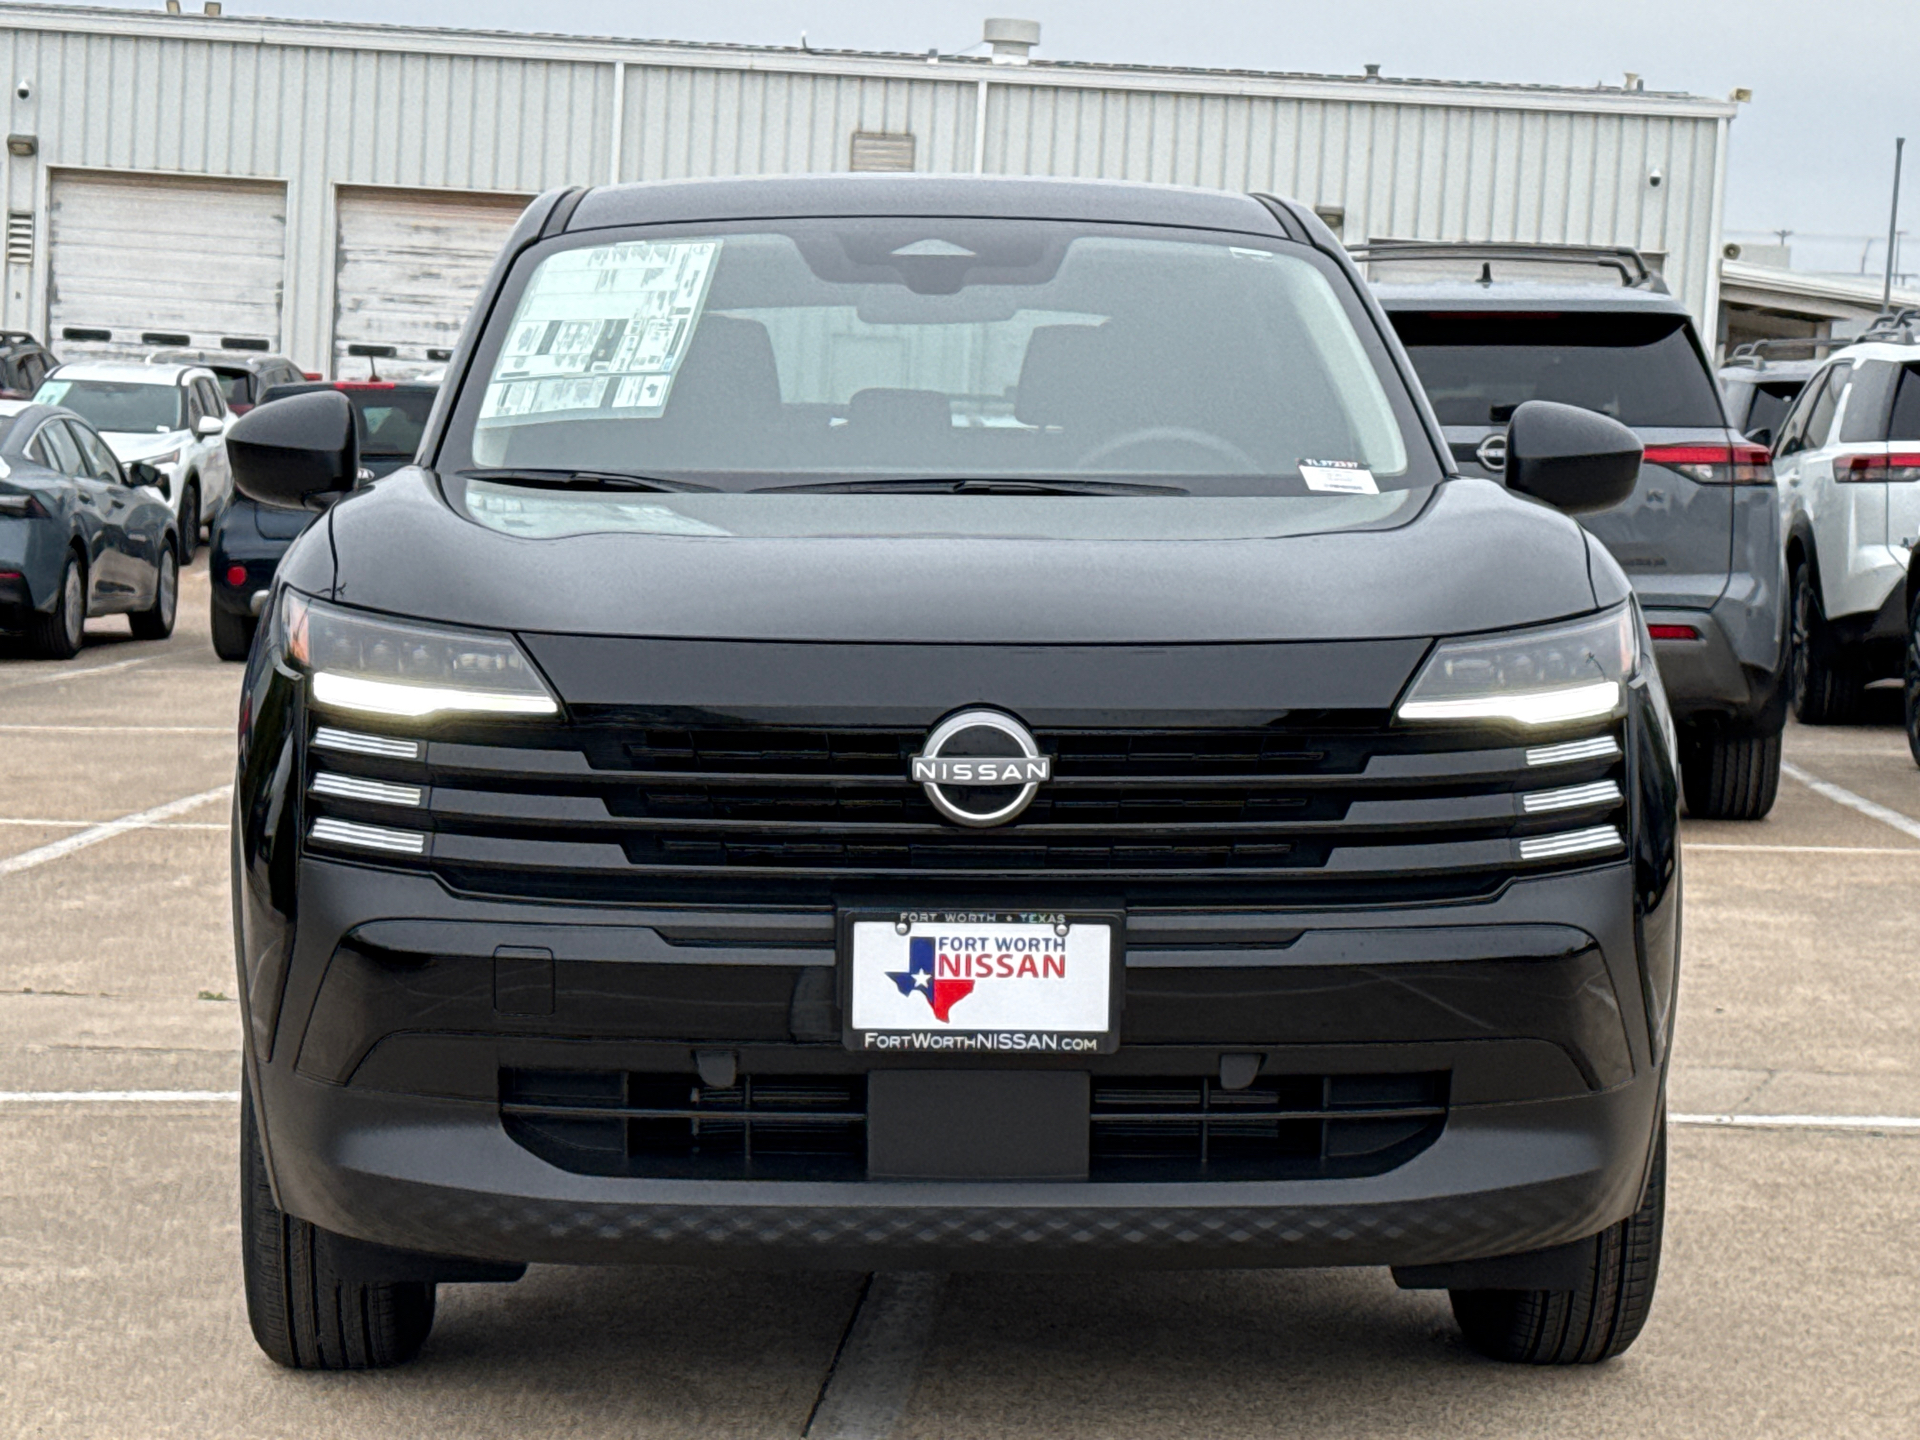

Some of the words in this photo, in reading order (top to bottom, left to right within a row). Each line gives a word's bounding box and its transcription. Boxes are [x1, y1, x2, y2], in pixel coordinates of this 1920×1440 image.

[916, 761, 1047, 781] NISSAN
[900, 912, 937, 923] FORT
[945, 913, 997, 923] WORTH
[1020, 913, 1067, 924] TEXAS
[938, 936, 988, 952] FORT
[995, 937, 1066, 952] WORTH
[938, 953, 1066, 979] NISSAN
